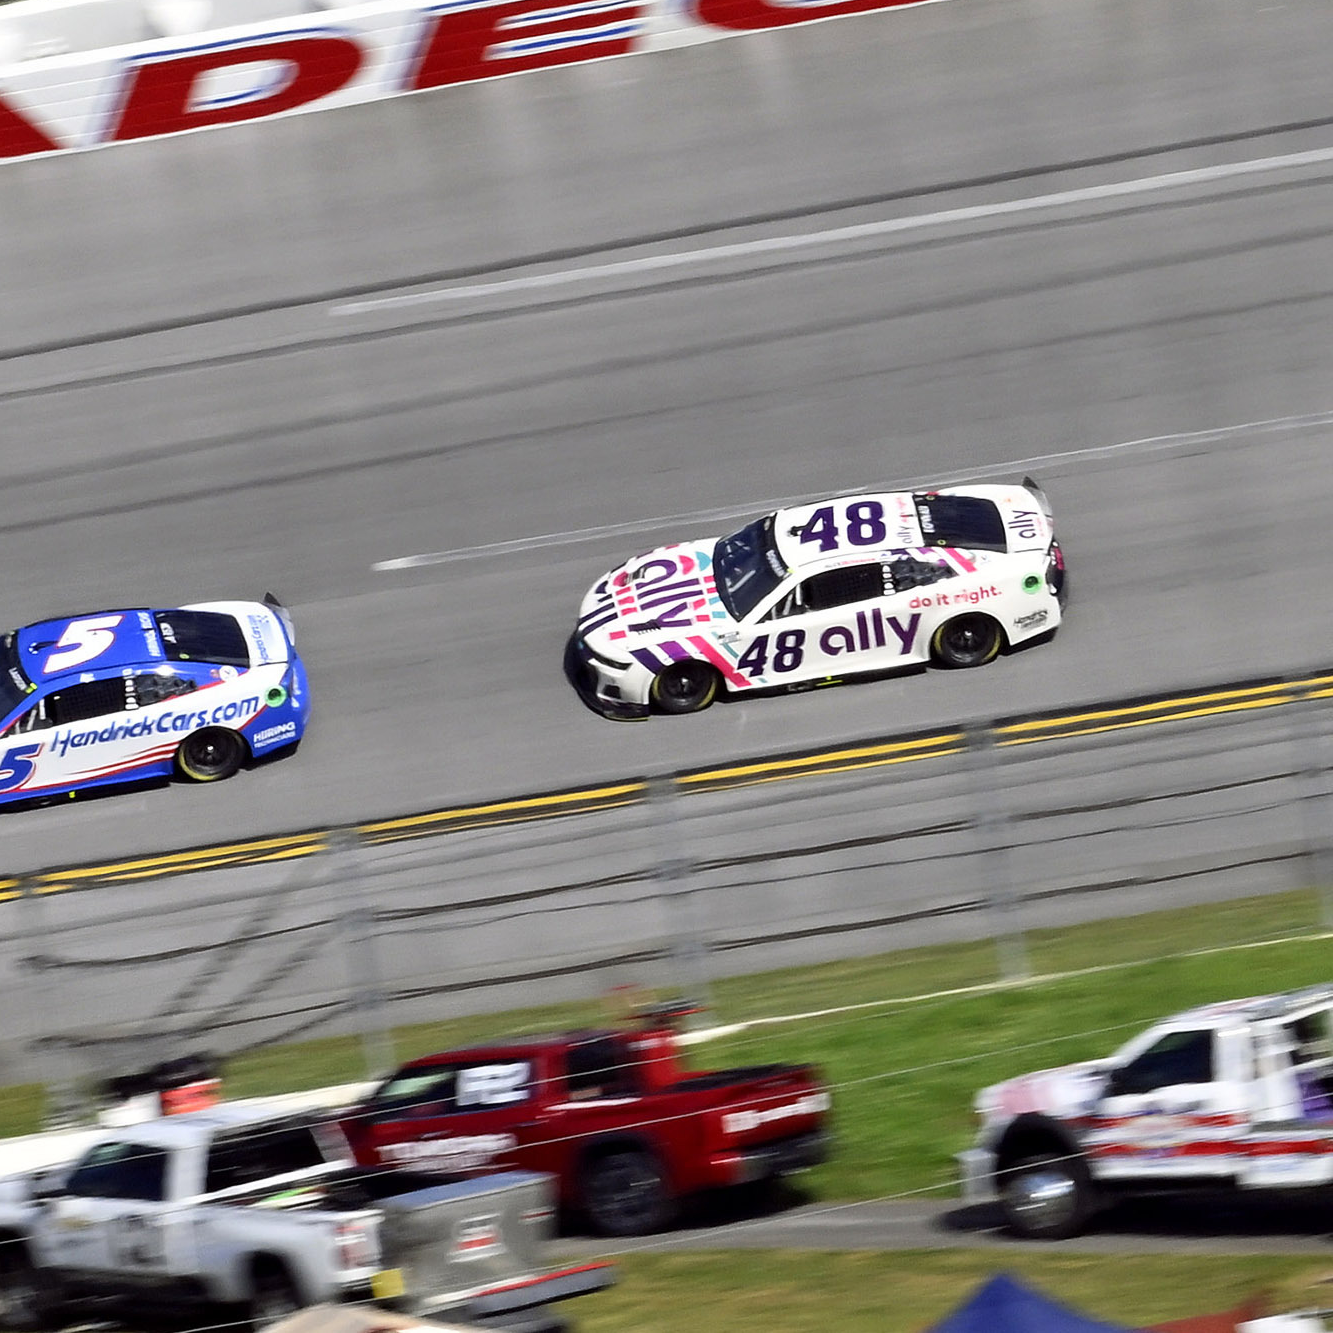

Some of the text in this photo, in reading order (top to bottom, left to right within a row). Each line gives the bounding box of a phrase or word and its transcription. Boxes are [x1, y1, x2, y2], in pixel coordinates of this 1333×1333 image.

[800, 501, 886, 552] 48
[1007, 509, 1038, 539] ally
[909, 597, 932, 609] do
[937, 593, 950, 606] it
[43, 615, 126, 674] 5
[737, 608, 921, 677] 48 ally
[49, 696, 261, 757] HendrickCars.com
